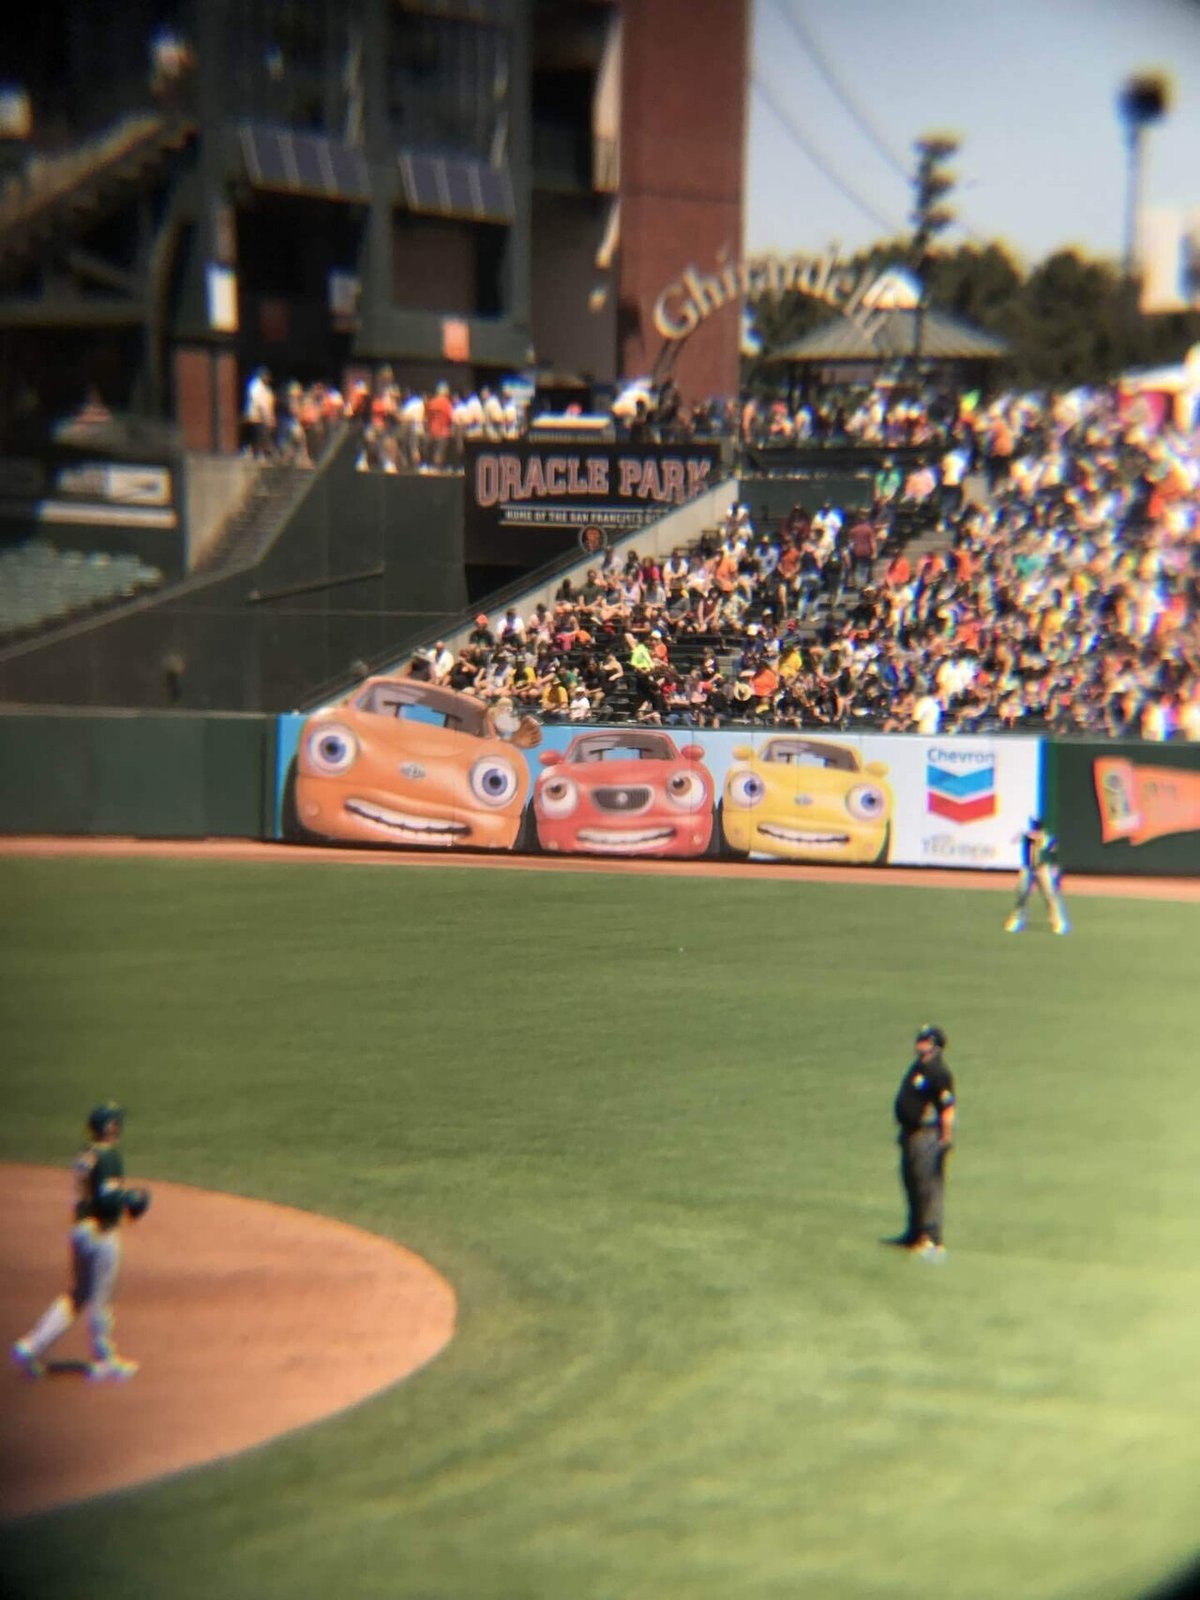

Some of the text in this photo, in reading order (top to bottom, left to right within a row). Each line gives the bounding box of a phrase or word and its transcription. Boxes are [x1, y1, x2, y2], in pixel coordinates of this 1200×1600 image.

[476, 454, 712, 508] ORACLE PARK
[506, 510, 532, 521] HOME
[535, 511, 546, 521] OF
[550, 511, 567, 522] THE
[570, 511, 589, 522] SAN
[927, 747, 996, 765] Chevron
